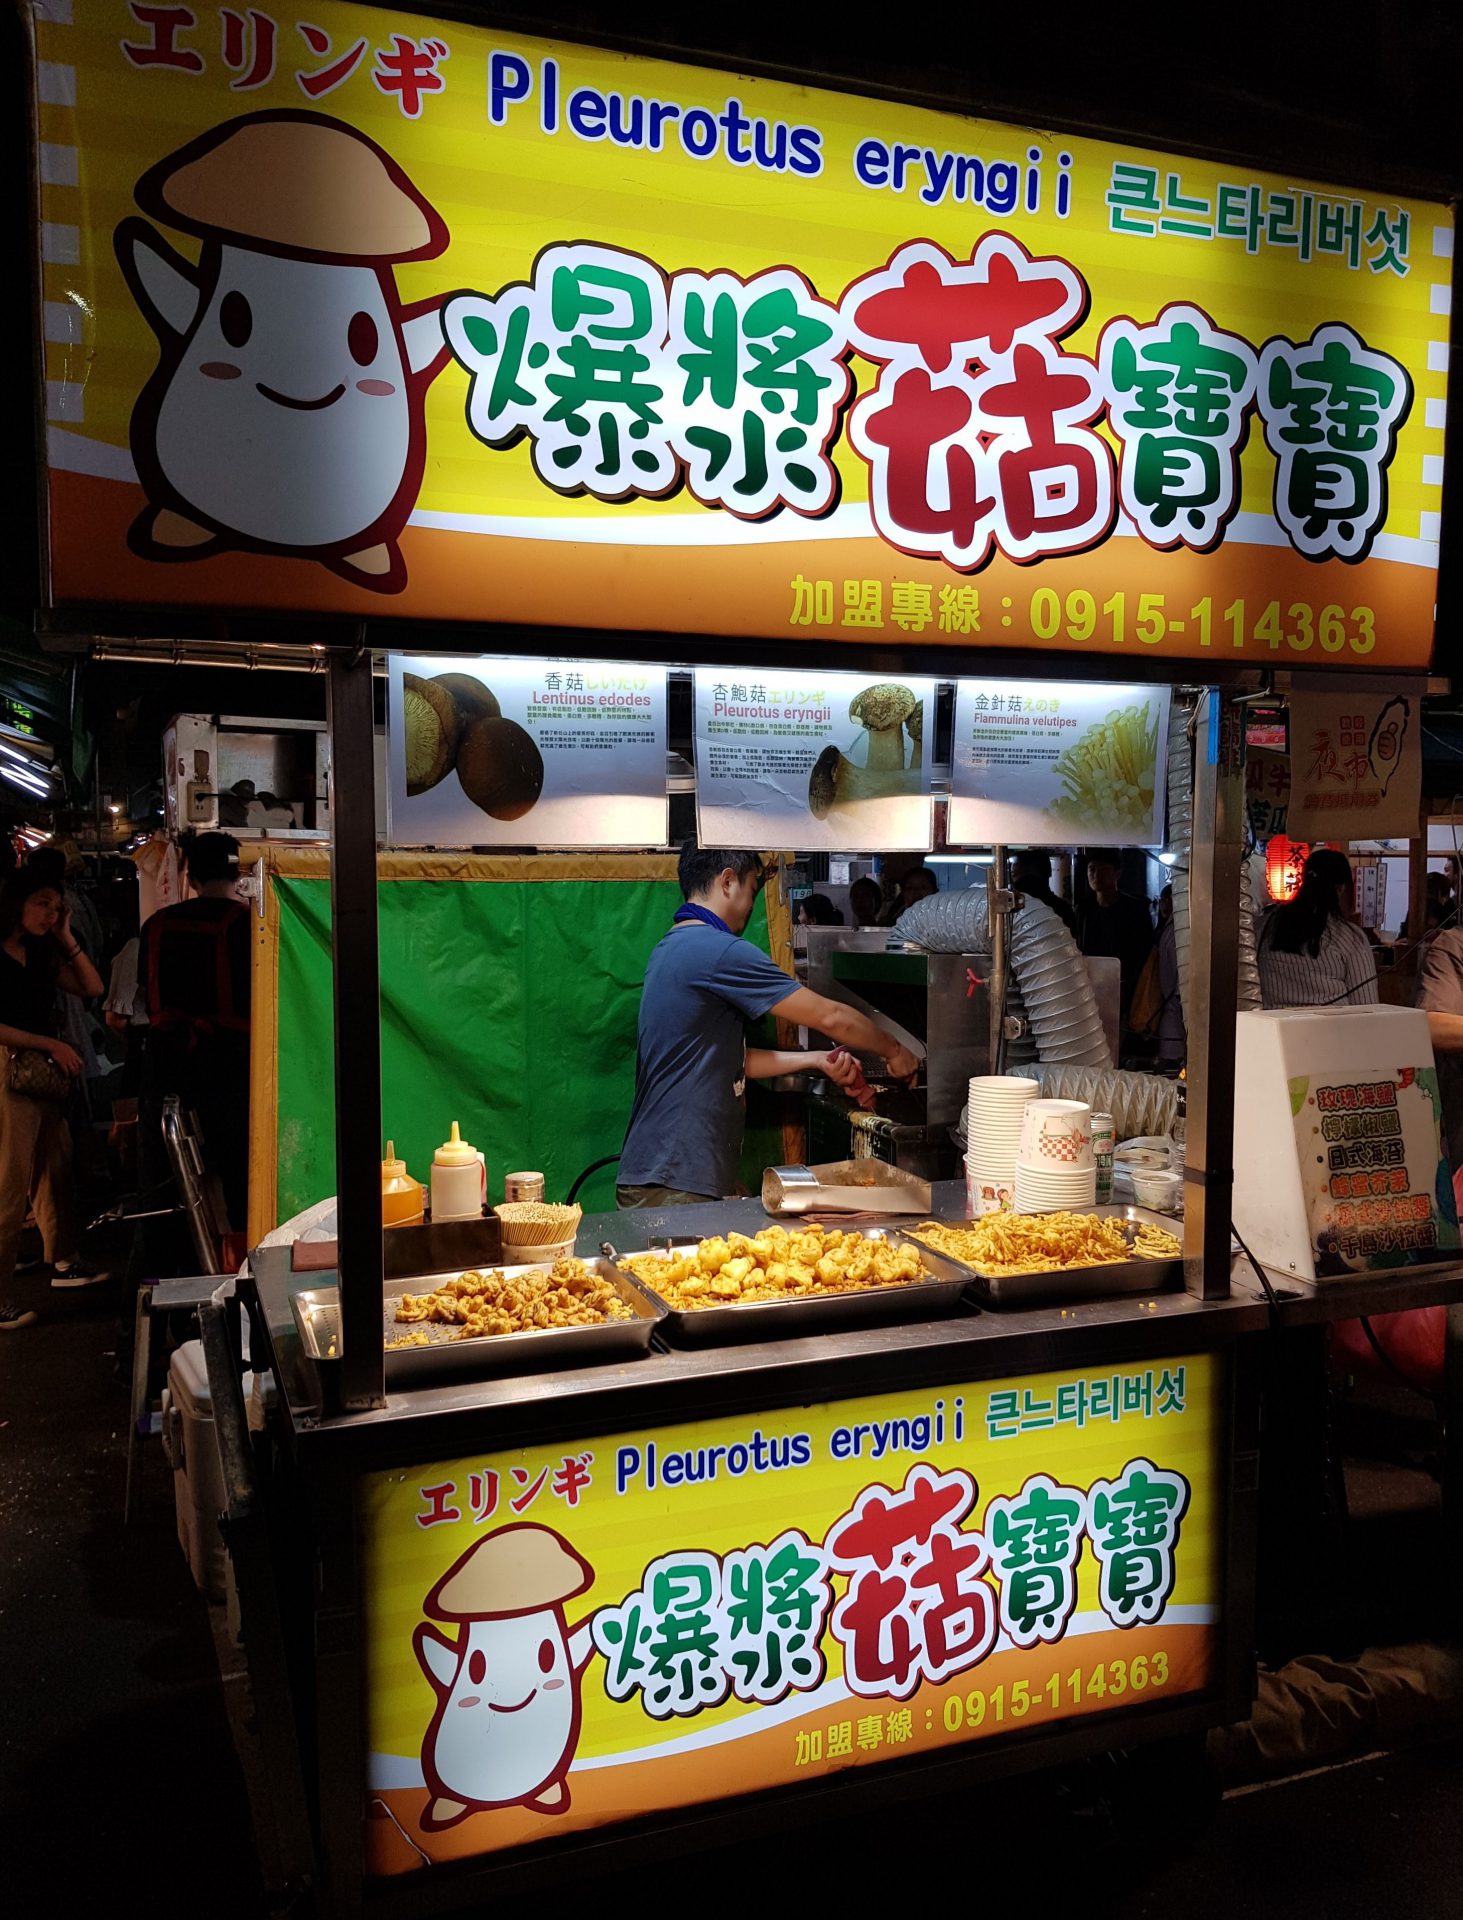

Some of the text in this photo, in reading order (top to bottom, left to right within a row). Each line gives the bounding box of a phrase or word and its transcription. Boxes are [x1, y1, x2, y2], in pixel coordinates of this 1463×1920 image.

[122, 4, 448, 118] エリンギ
[489, 52, 1072, 216] Pleurotus eryngii
[1106, 163, 1411, 277] 큰느타리버섯
[462, 250, 1397, 550] 爆漿菇寶寶
[533, 691, 651, 707] Lentinus edodes
[713, 703, 831, 723] Pleurotus eryngii
[974, 713, 1077, 729] Flammulina velutipes
[1329, 1140, 1403, 1169] 日式海苔
[616, 1398, 965, 1494] Pleurotus eryngii
[985, 1367, 1187, 1438] 큰느타리버섯
[415, 1451, 593, 1530] エリンギ
[604, 1470, 1182, 1700] 爆漿菇寶寶
